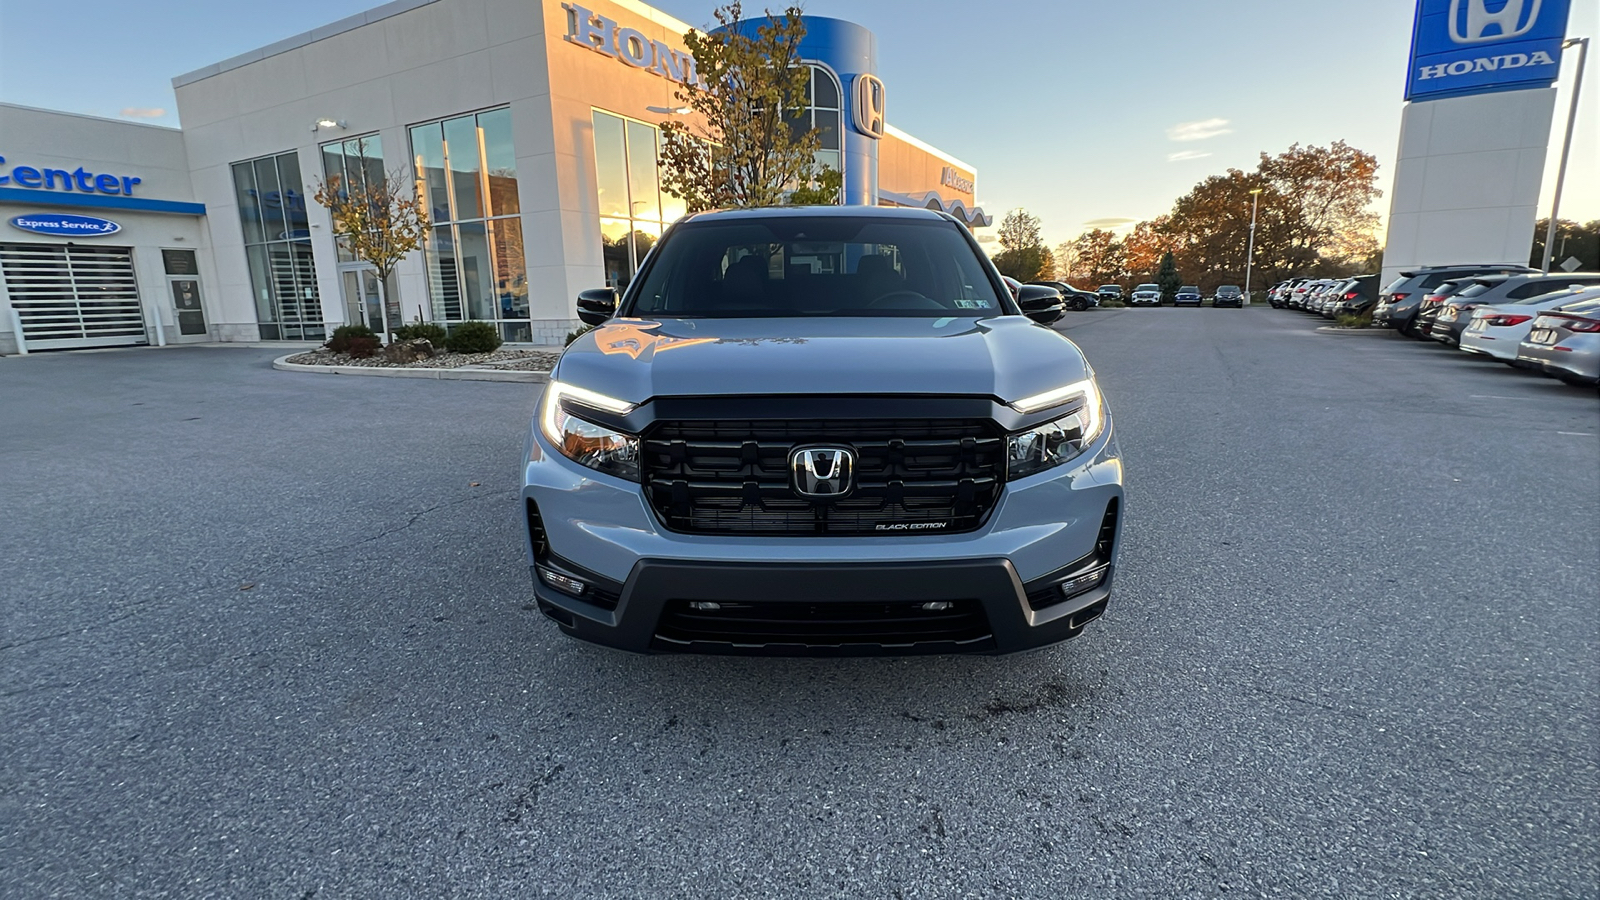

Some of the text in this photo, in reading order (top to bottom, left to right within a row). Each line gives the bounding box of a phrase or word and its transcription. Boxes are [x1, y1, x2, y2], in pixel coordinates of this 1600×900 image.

[1418, 51, 1555, 80] HONDA
[17, 218, 100, 230] Express Service
[909, 522, 947, 530] EDITION
